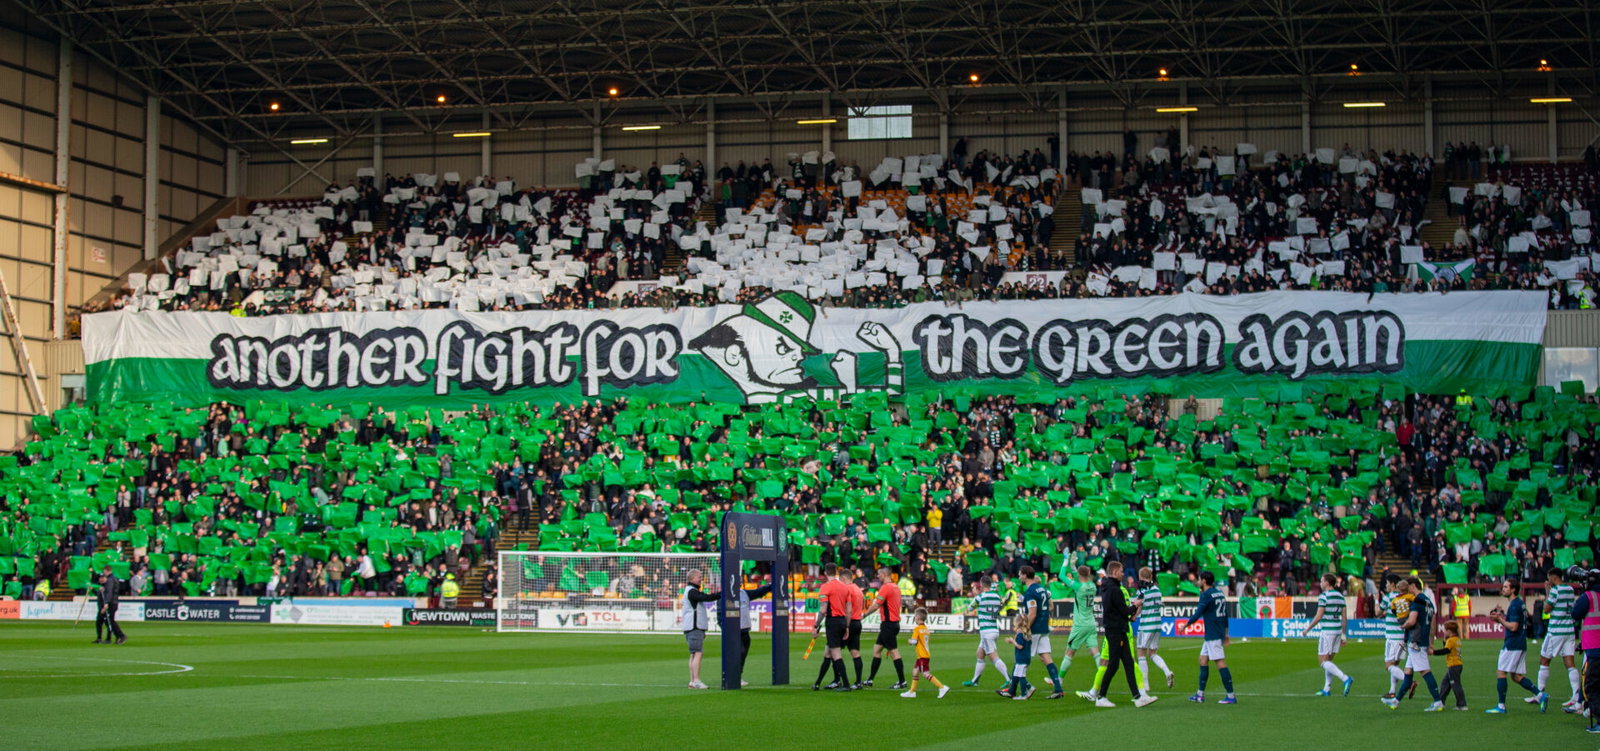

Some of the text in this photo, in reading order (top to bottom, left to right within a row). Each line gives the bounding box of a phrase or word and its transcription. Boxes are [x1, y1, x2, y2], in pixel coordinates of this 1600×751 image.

[146, 608, 176, 618] CASTLE
[189, 609, 220, 619] WATER
[412, 611, 469, 622] NEWTOWN
[471, 612, 496, 620] WASTE
[591, 612, 621, 622] TCL
[1493, 622, 1503, 633] FC
